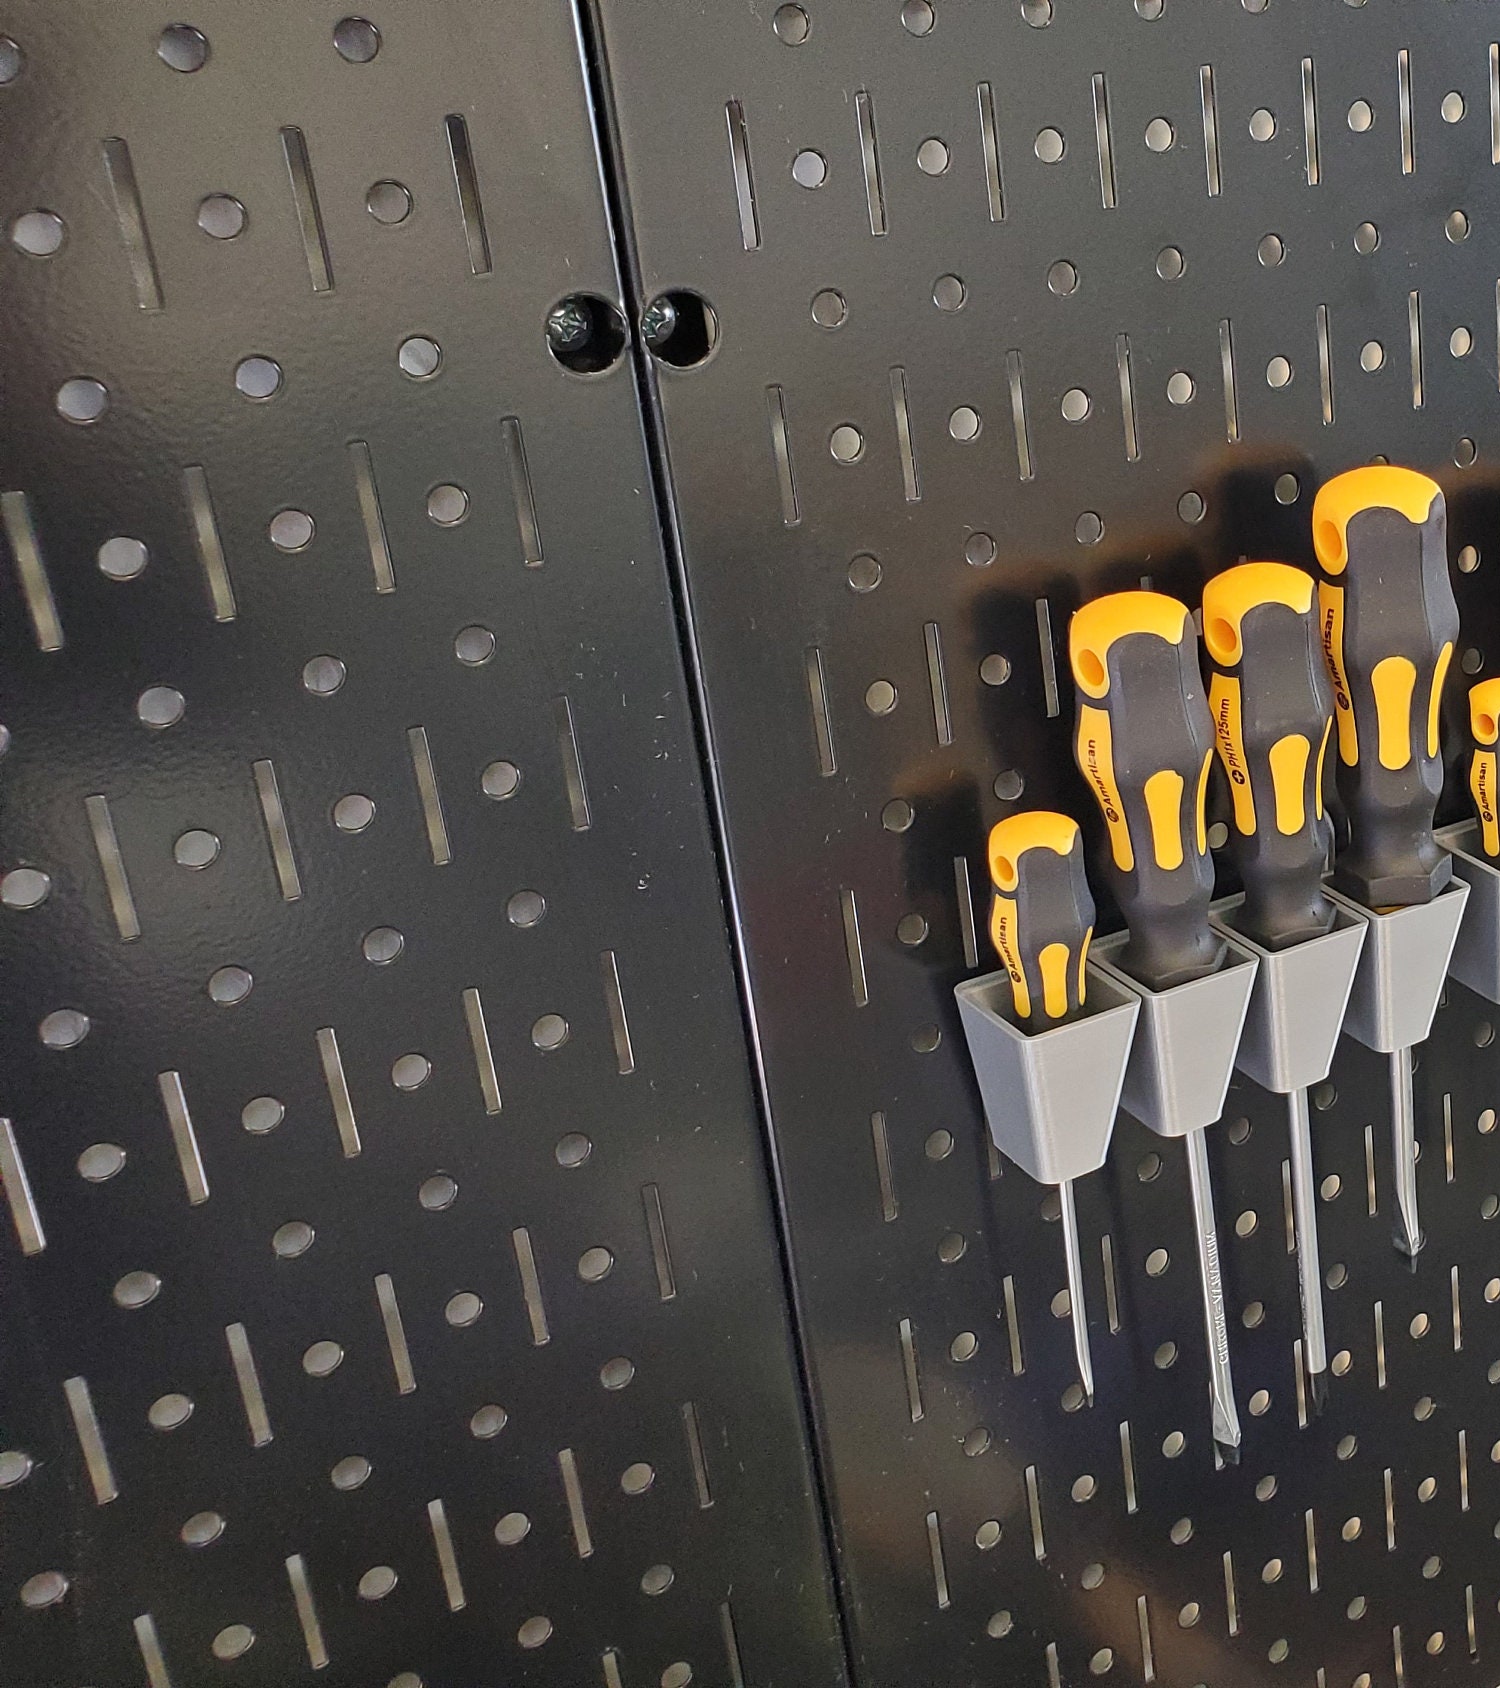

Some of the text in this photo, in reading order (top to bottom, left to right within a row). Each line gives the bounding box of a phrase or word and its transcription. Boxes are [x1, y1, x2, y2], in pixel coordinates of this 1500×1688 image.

[1323, 608, 1344, 691] Amartisan
[1218, 698, 1240, 768] PH1x125mm
[1477, 762, 1491, 811] Amartisan
[998, 917, 1018, 970] Amartisan
